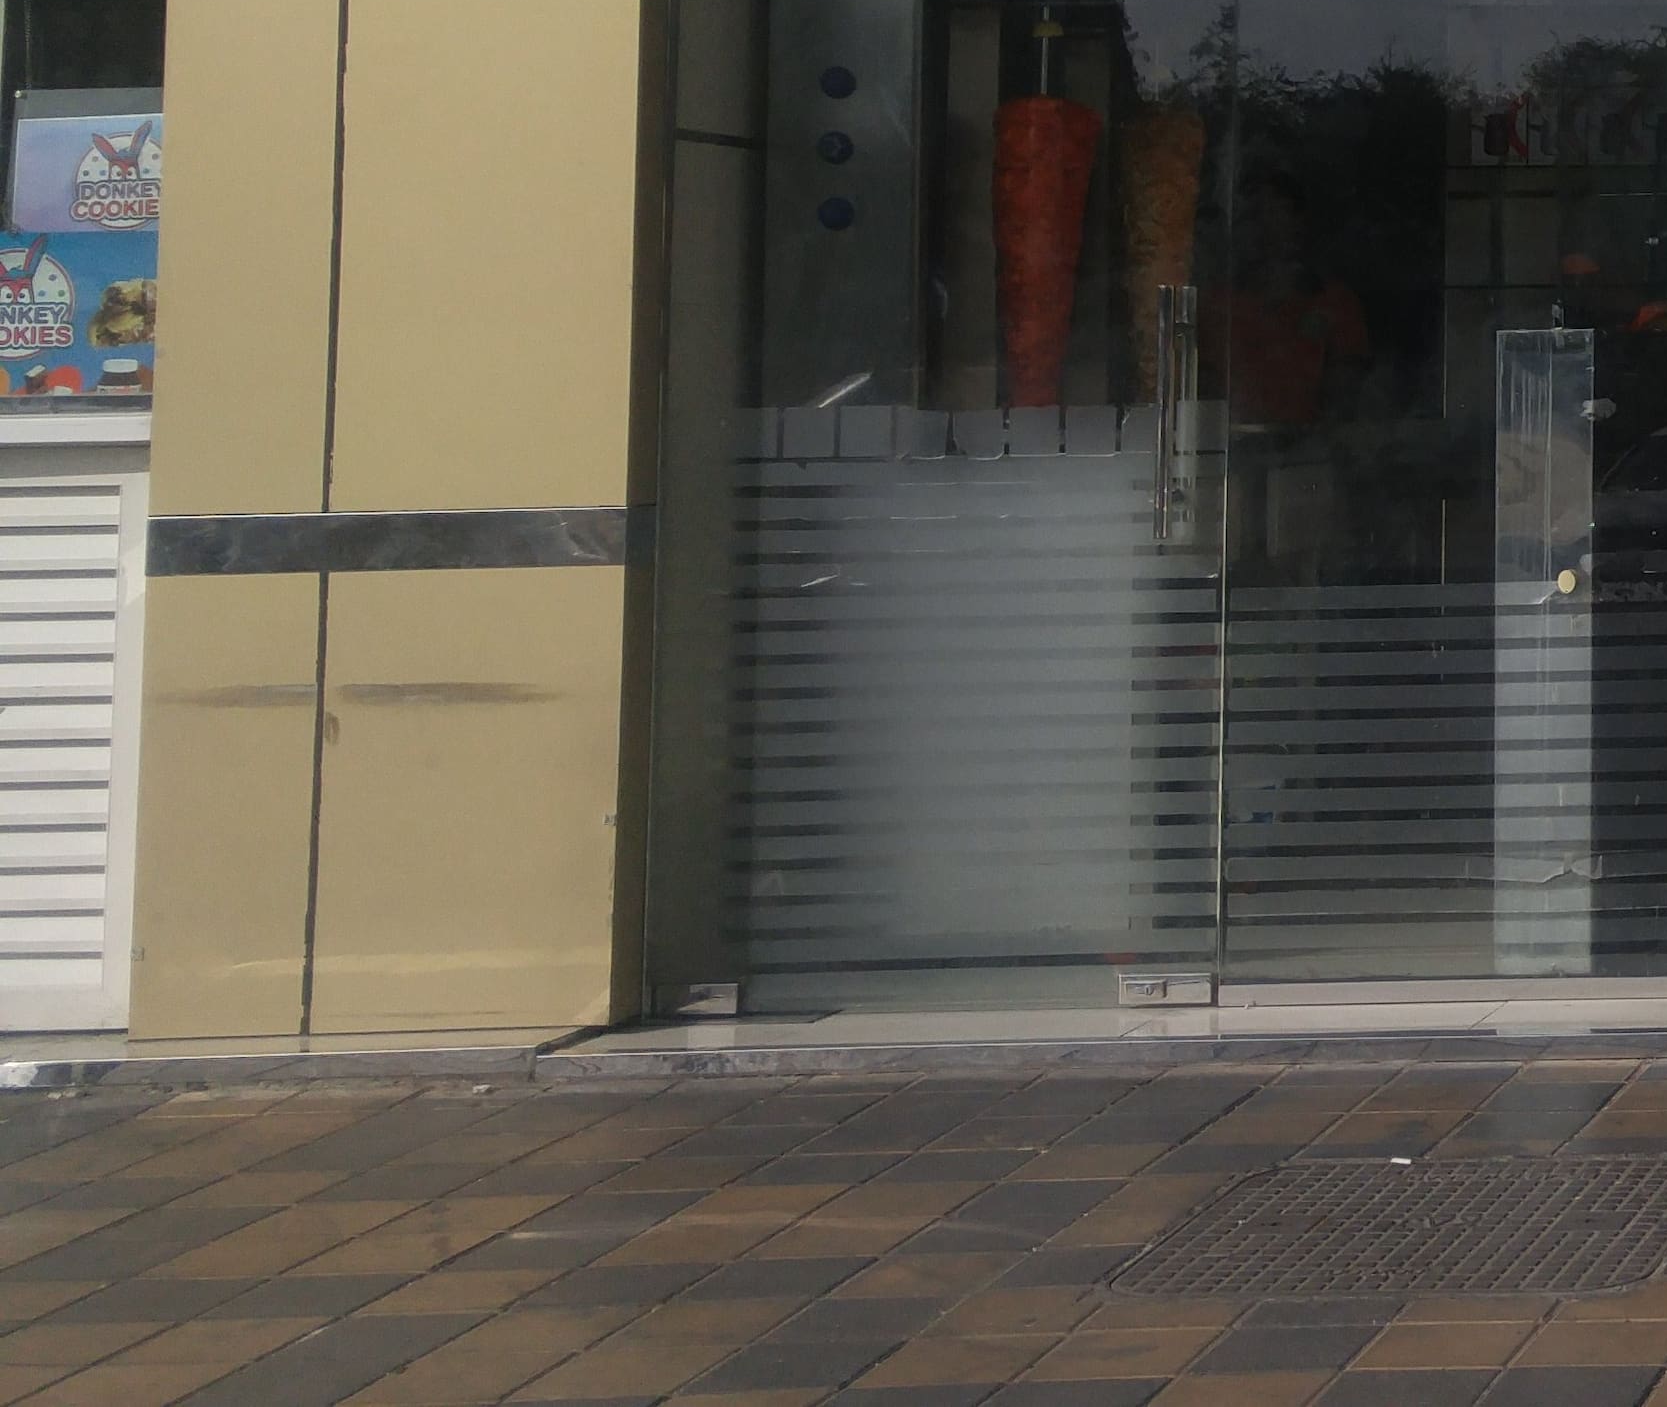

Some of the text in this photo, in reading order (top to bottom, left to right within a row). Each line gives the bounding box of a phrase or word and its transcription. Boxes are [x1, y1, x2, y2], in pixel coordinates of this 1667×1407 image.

[71, 199, 159, 219] COOKIE
[0, 305, 65, 325] NKEY
[0, 325, 72, 346] OKIES
